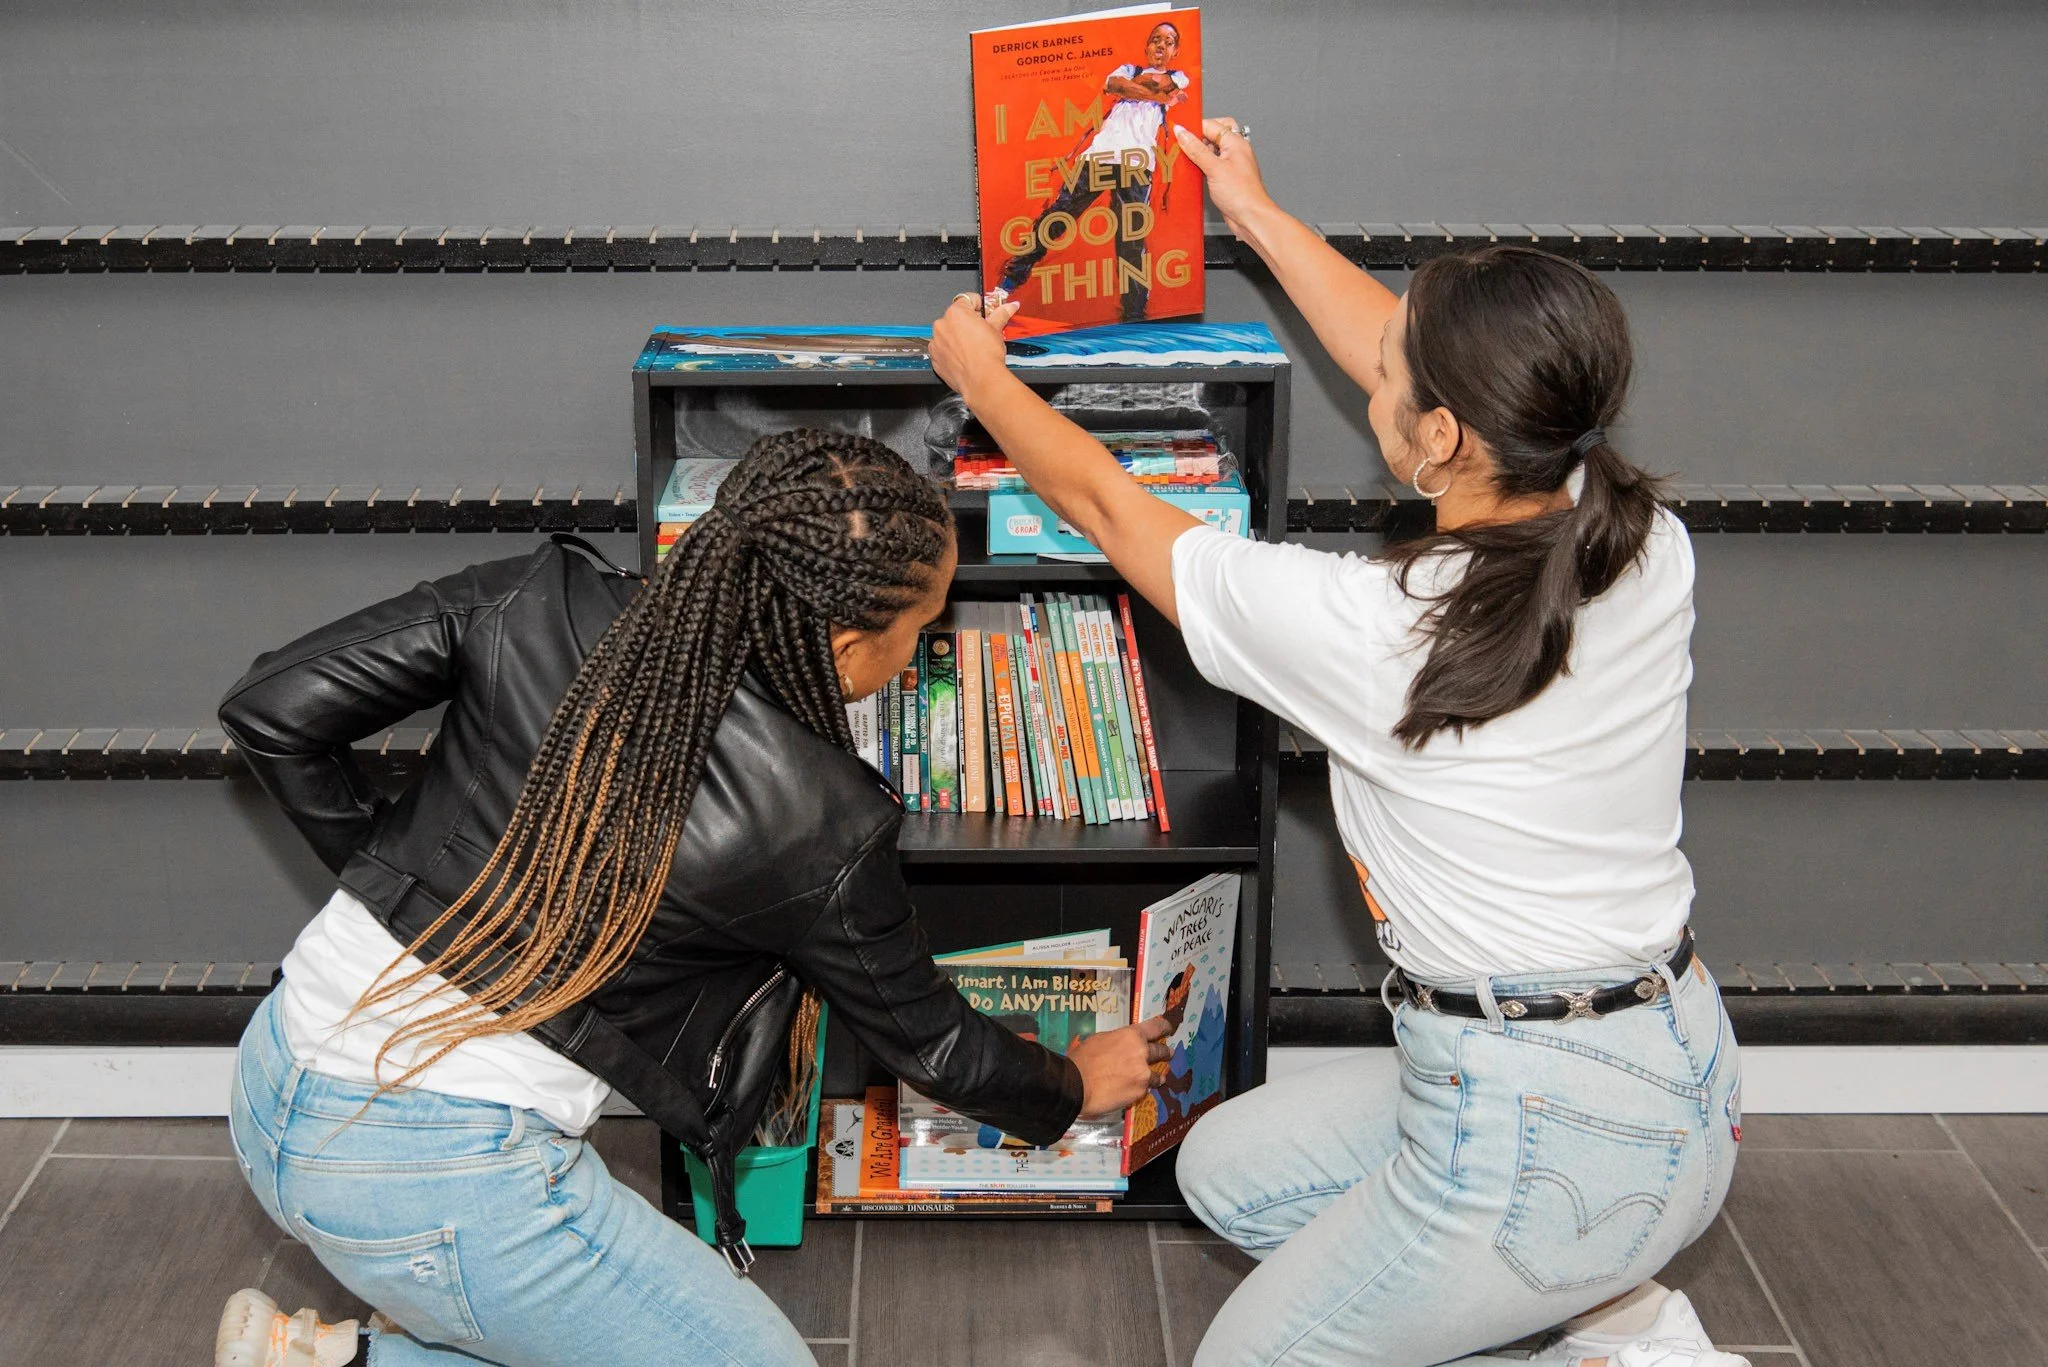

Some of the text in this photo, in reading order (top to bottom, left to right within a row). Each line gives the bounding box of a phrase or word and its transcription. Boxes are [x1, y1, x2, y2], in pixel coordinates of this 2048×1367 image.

[993, 35, 1084, 53] DERRICK BARNES
[1016, 48, 1113, 66] GORDON C. JAMES
[995, 93, 1104, 145] I AM
[1025, 142, 1181, 199] EVERY
[1000, 202, 1155, 256] GOOD
[1032, 249, 1191, 305] THING
[1020, 524, 1038, 534] ROAR
[1077, 622, 1087, 641] SCIENCE
[1090, 623, 1100, 641] SCIENCE
[1103, 622, 1113, 641] SCIENCE
[967, 635, 975, 661] CURTIS
[1081, 641, 1089, 657] COMICS
[1094, 641, 1103, 657] COMICS
[1107, 641, 1116, 657] COMICS
[1008, 648, 1017, 681] CREECH
[1058, 656, 1068, 685] COLLIER
[1071, 656, 1082, 685] COLLIER
[1131, 658, 1139, 672] Are
[1112, 668, 1122, 701] SHARKS
[1134, 673, 1142, 686] You
[1088, 684, 1099, 708] BRAIN
[1099, 667, 1112, 714] DINOSAURS
[891, 682, 899, 732] HATCHET
[967, 693, 977, 722] MIGHTY
[1136, 687, 1148, 718] Smarter
[919, 716, 927, 737] DRAGON
[989, 718, 997, 728] EAT
[1056, 725, 1066, 740] JAKE
[1068, 713, 1078, 733] SHOE
[1082, 713, 1091, 733] SHOE
[1143, 719, 1152, 739] Than
[991, 732, 999, 747] FRIED
[1019, 732, 1027, 758] THAT
[1071, 734, 1081, 753] TIME!
[1084, 734, 1094, 754] TIME!
[1097, 728, 1108, 762] WOOLLCOTT
[992, 751, 1000, 770] WORMS
[1059, 745, 1069, 761] FAKE
[1147, 745, 1158, 772] SHARK?
[969, 749, 979, 782] MALONE
[1004, 756, 1012, 783] zamora
[1010, 758, 1019, 783] arturo
[1021, 762, 1029, 781] DOG
[1163, 895, 1226, 945] WANGARI'S
[1180, 914, 1208, 941] TREES
[1137, 928, 1145, 955] WINTER
[1170, 945, 1183, 961] OF
[1183, 927, 1213, 955] PEACE
[957, 974, 1008, 991] Smart,
[1011, 975, 1017, 988] I
[1021, 975, 1048, 989] Am
[1052, 975, 1115, 993] Blessed,
[969, 993, 1119, 1013] Do ANYTHING!
[870, 1142, 894, 1161] Are
[870, 1162, 892, 1179] We
[907, 1204, 955, 1212] DINOSAURS
